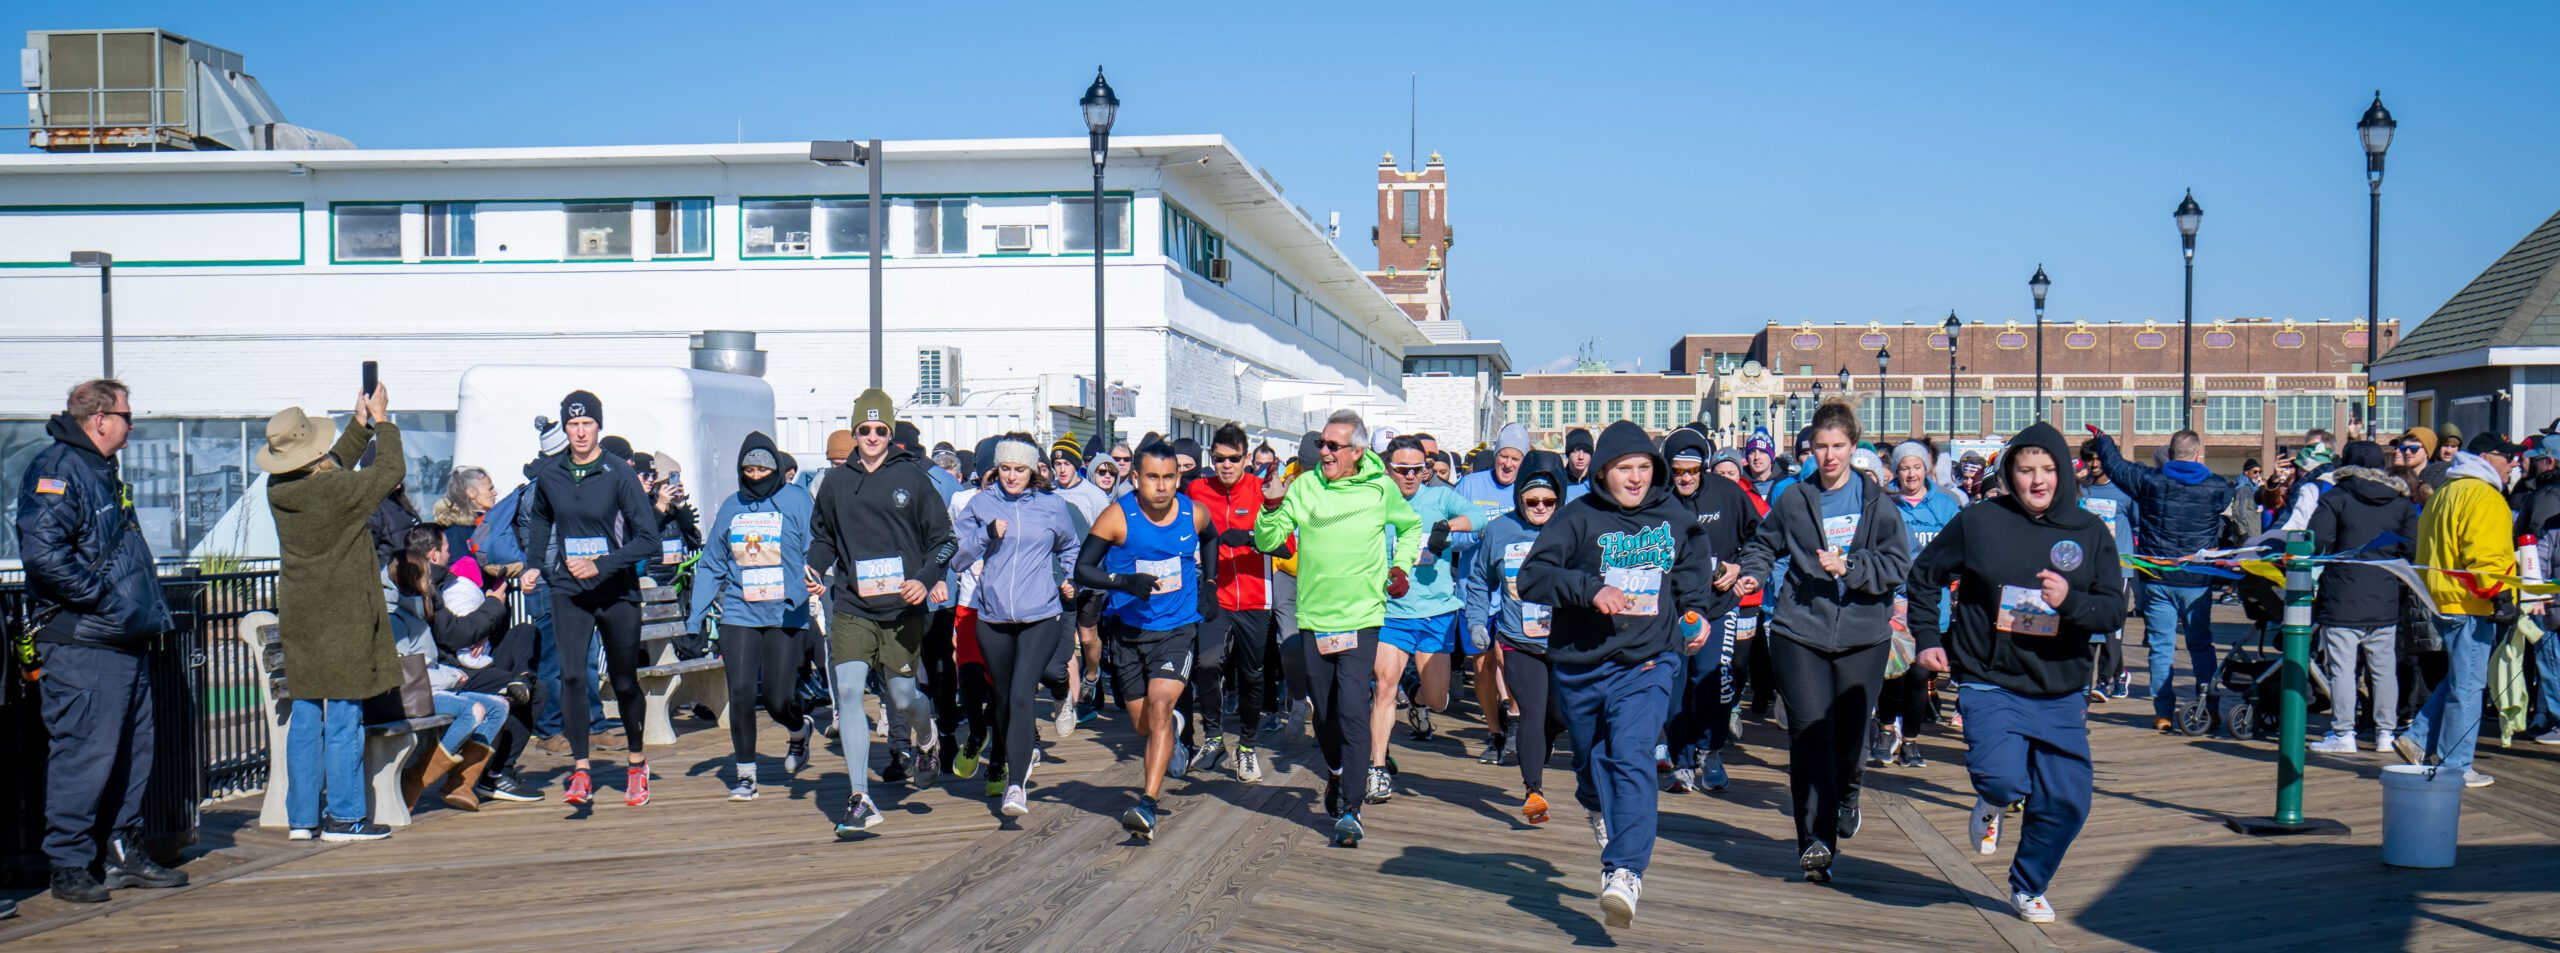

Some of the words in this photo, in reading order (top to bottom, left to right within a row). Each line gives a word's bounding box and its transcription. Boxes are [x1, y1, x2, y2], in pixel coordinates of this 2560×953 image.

[1697, 511, 1720, 523] 1776
[1830, 527, 1851, 535] DASH
[1597, 521, 1675, 556] Hornet
[576, 542, 598, 555] 140
[1600, 547, 1662, 572] Nation
[868, 564, 892, 578] 200
[1621, 575, 1650, 593] 307
